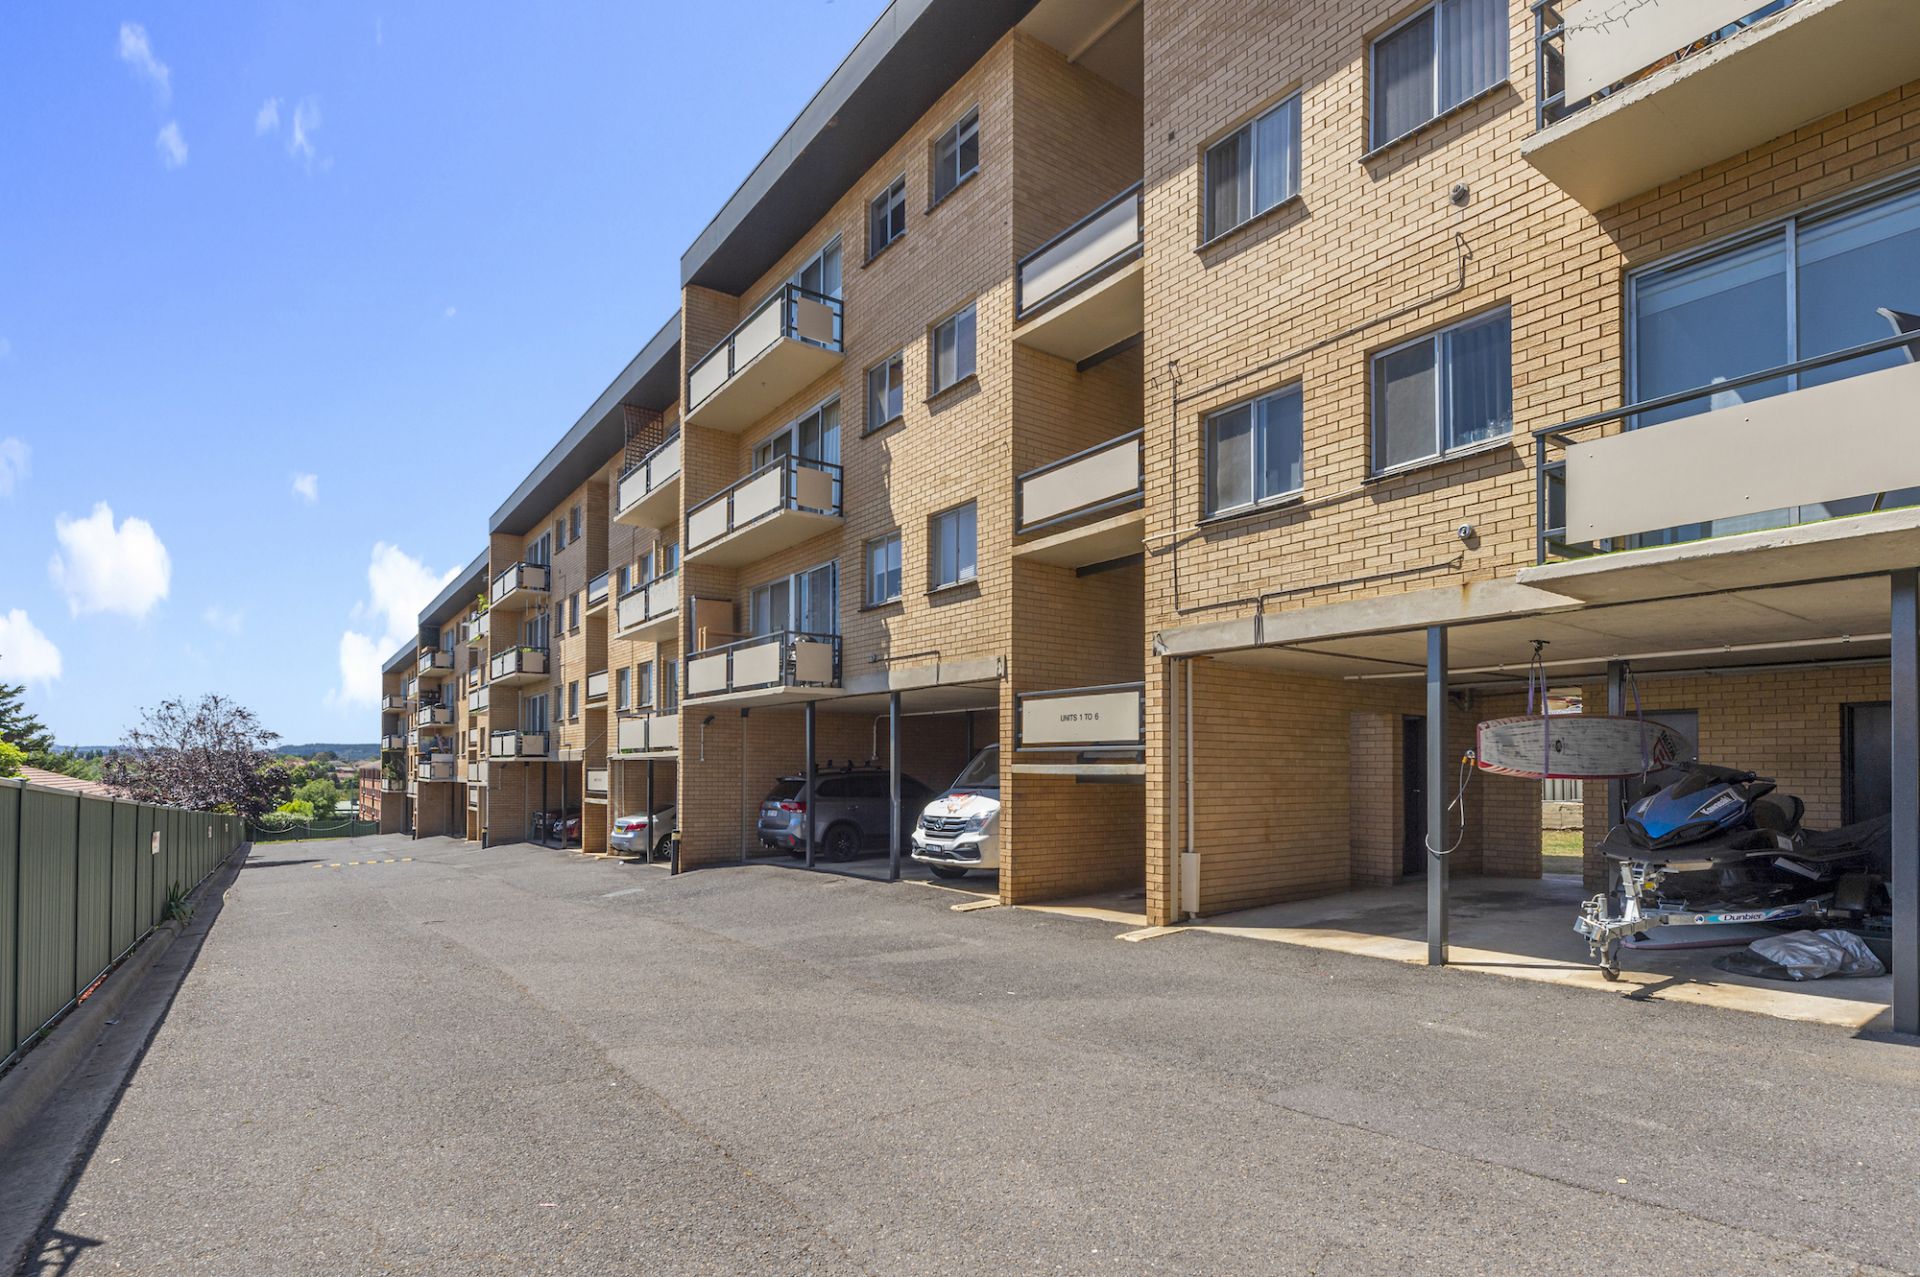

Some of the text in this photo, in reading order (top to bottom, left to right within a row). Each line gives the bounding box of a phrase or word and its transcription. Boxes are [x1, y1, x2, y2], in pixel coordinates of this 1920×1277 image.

[1060, 713, 1078, 722] UNITS
[1084, 712, 1093, 721] TO
[1094, 712, 1099, 721] 6
[1723, 912, 1762, 921] Dunbier
